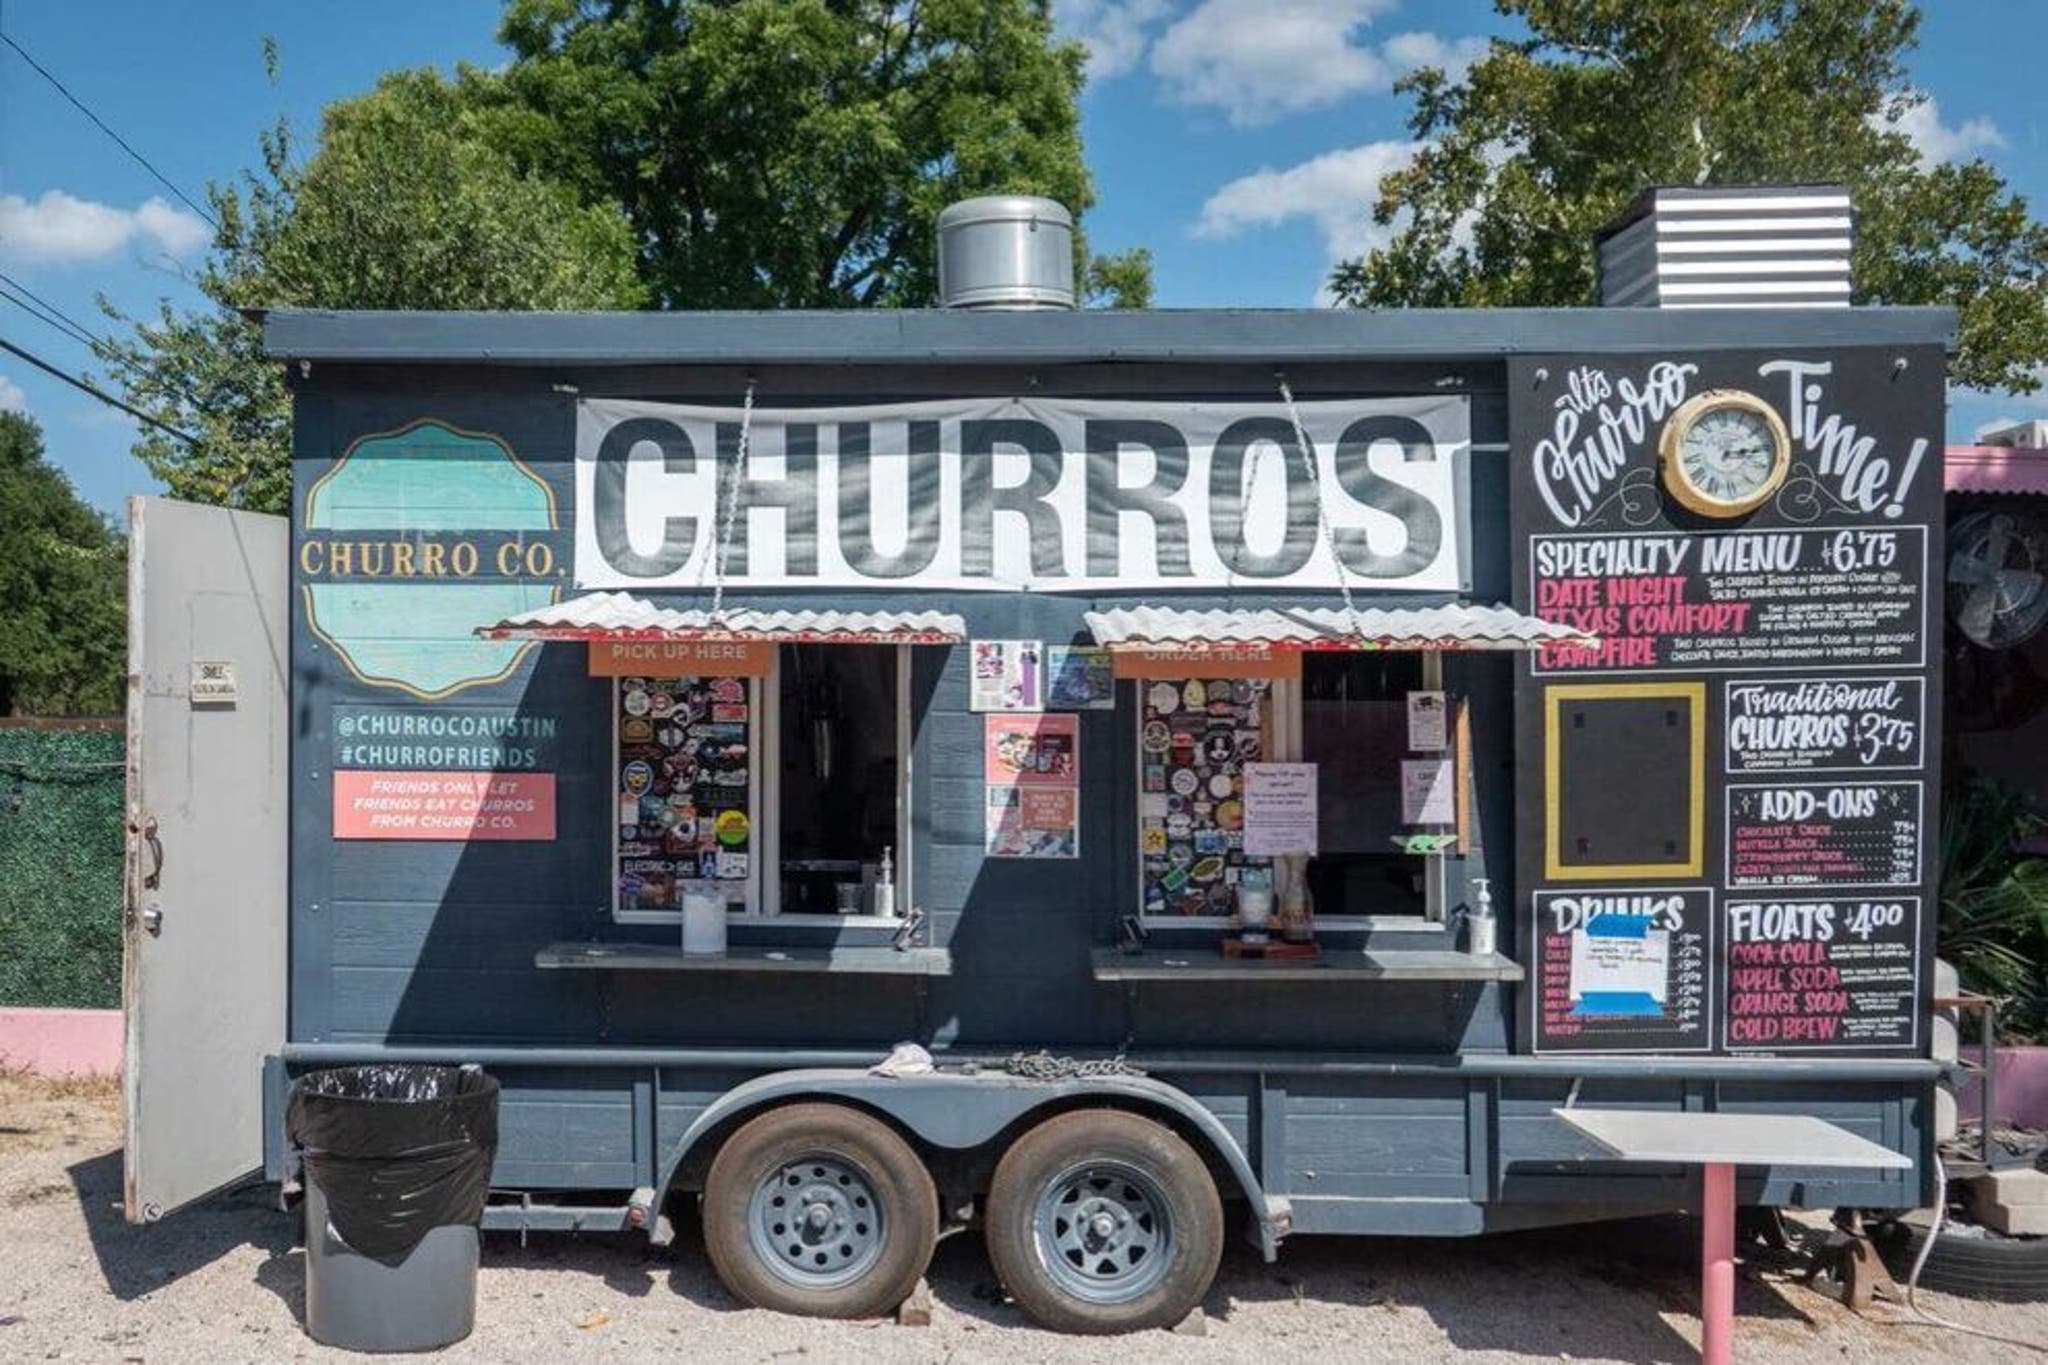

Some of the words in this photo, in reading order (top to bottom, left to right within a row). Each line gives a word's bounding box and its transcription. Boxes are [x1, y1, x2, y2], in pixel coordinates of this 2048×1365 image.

[1533, 361, 1698, 527] Churro
[1758, 360, 1929, 518] Time!
[596, 414, 1443, 580] CHURROS
[301, 541, 479, 576] CHURRO
[497, 541, 566, 577] CO.
[1537, 539, 1690, 577] SPECIALTY
[1538, 577, 1601, 608] DATE
[1608, 575, 1688, 606] NIGHT
[1628, 603, 1752, 634] COMFORT
[612, 644, 656, 659] PICK
[664, 644, 690, 659] UP
[696, 644, 747, 659] HERE
[1731, 681, 1902, 716] Traditional
[338, 714, 556, 738] @CHURROCOAUSTIN
[1731, 715, 1848, 751] CHURROS
[341, 744, 537, 768] #CHURROFRIENDS
[371, 780, 440, 794] FRIENDS
[443, 780, 486, 794] ONLY
[490, 780, 518, 794] LET
[353, 797, 421, 811] FRIENDS
[425, 797, 459, 811] EAT
[460, 797, 535, 812] CHURROS
[1760, 788, 1879, 821] ADD-ONS
[370, 814, 417, 828] FROM
[420, 814, 486, 828] CHURRO
[1730, 904, 1836, 942] FLOATS
[1731, 943, 1826, 965] COCA-COLA
[1731, 968, 1785, 991] APPLE
[1790, 967, 1841, 991] SODA
[1731, 992, 1799, 1015] ORANGE
[1805, 991, 1849, 1013] SODA
[1731, 1018, 1778, 1041] COLD
[1782, 1017, 1839, 1040] BREW
